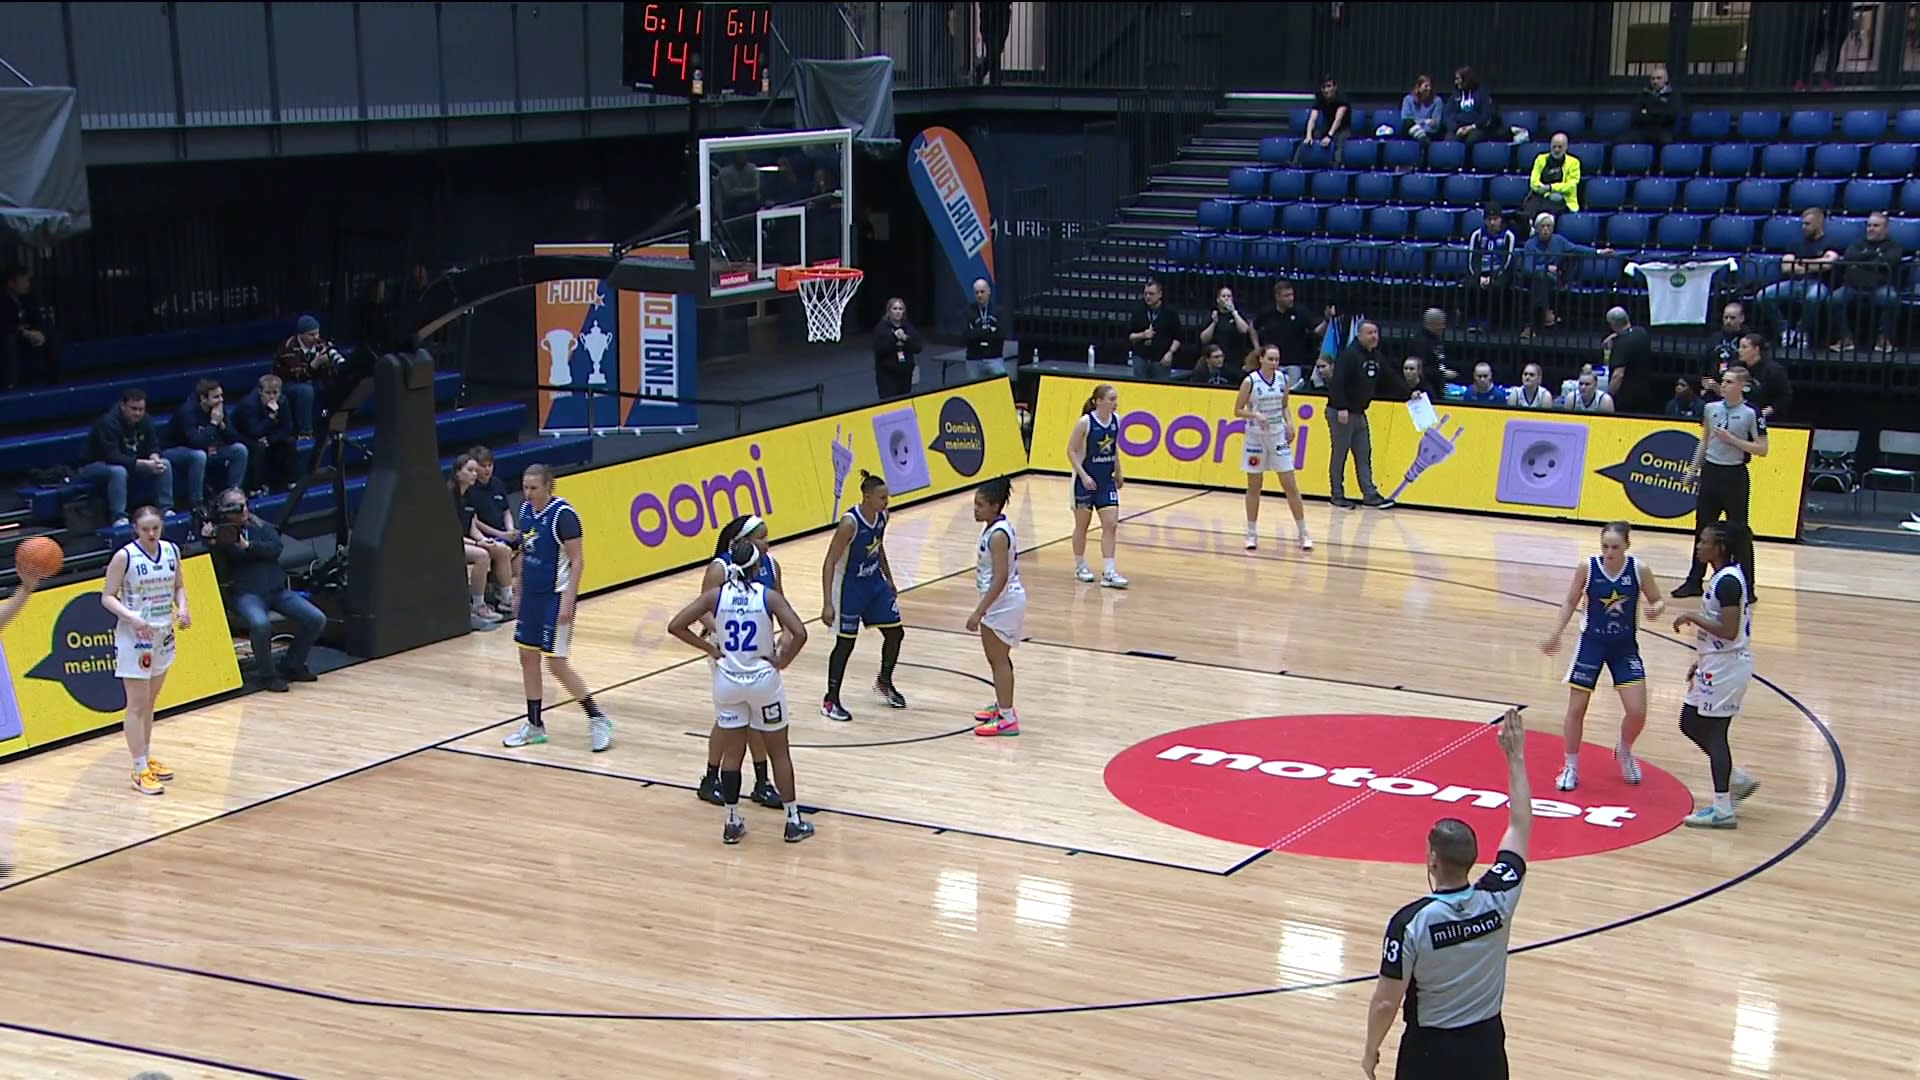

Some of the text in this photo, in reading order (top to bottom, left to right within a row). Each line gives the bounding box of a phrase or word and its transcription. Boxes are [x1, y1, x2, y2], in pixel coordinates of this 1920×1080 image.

[644, 4, 702, 35] 6:11
[727, 9, 769, 36] 6:11
[652, 39, 688, 80] 14
[732, 42, 758, 81] 14
[547, 280, 598, 304] FOUR
[644, 292, 674, 397] FINAL FO
[630, 443, 773, 547] oomi
[136, 563, 148, 576] 18
[724, 619, 758, 652] 32
[1155, 743, 1637, 828] motonet
